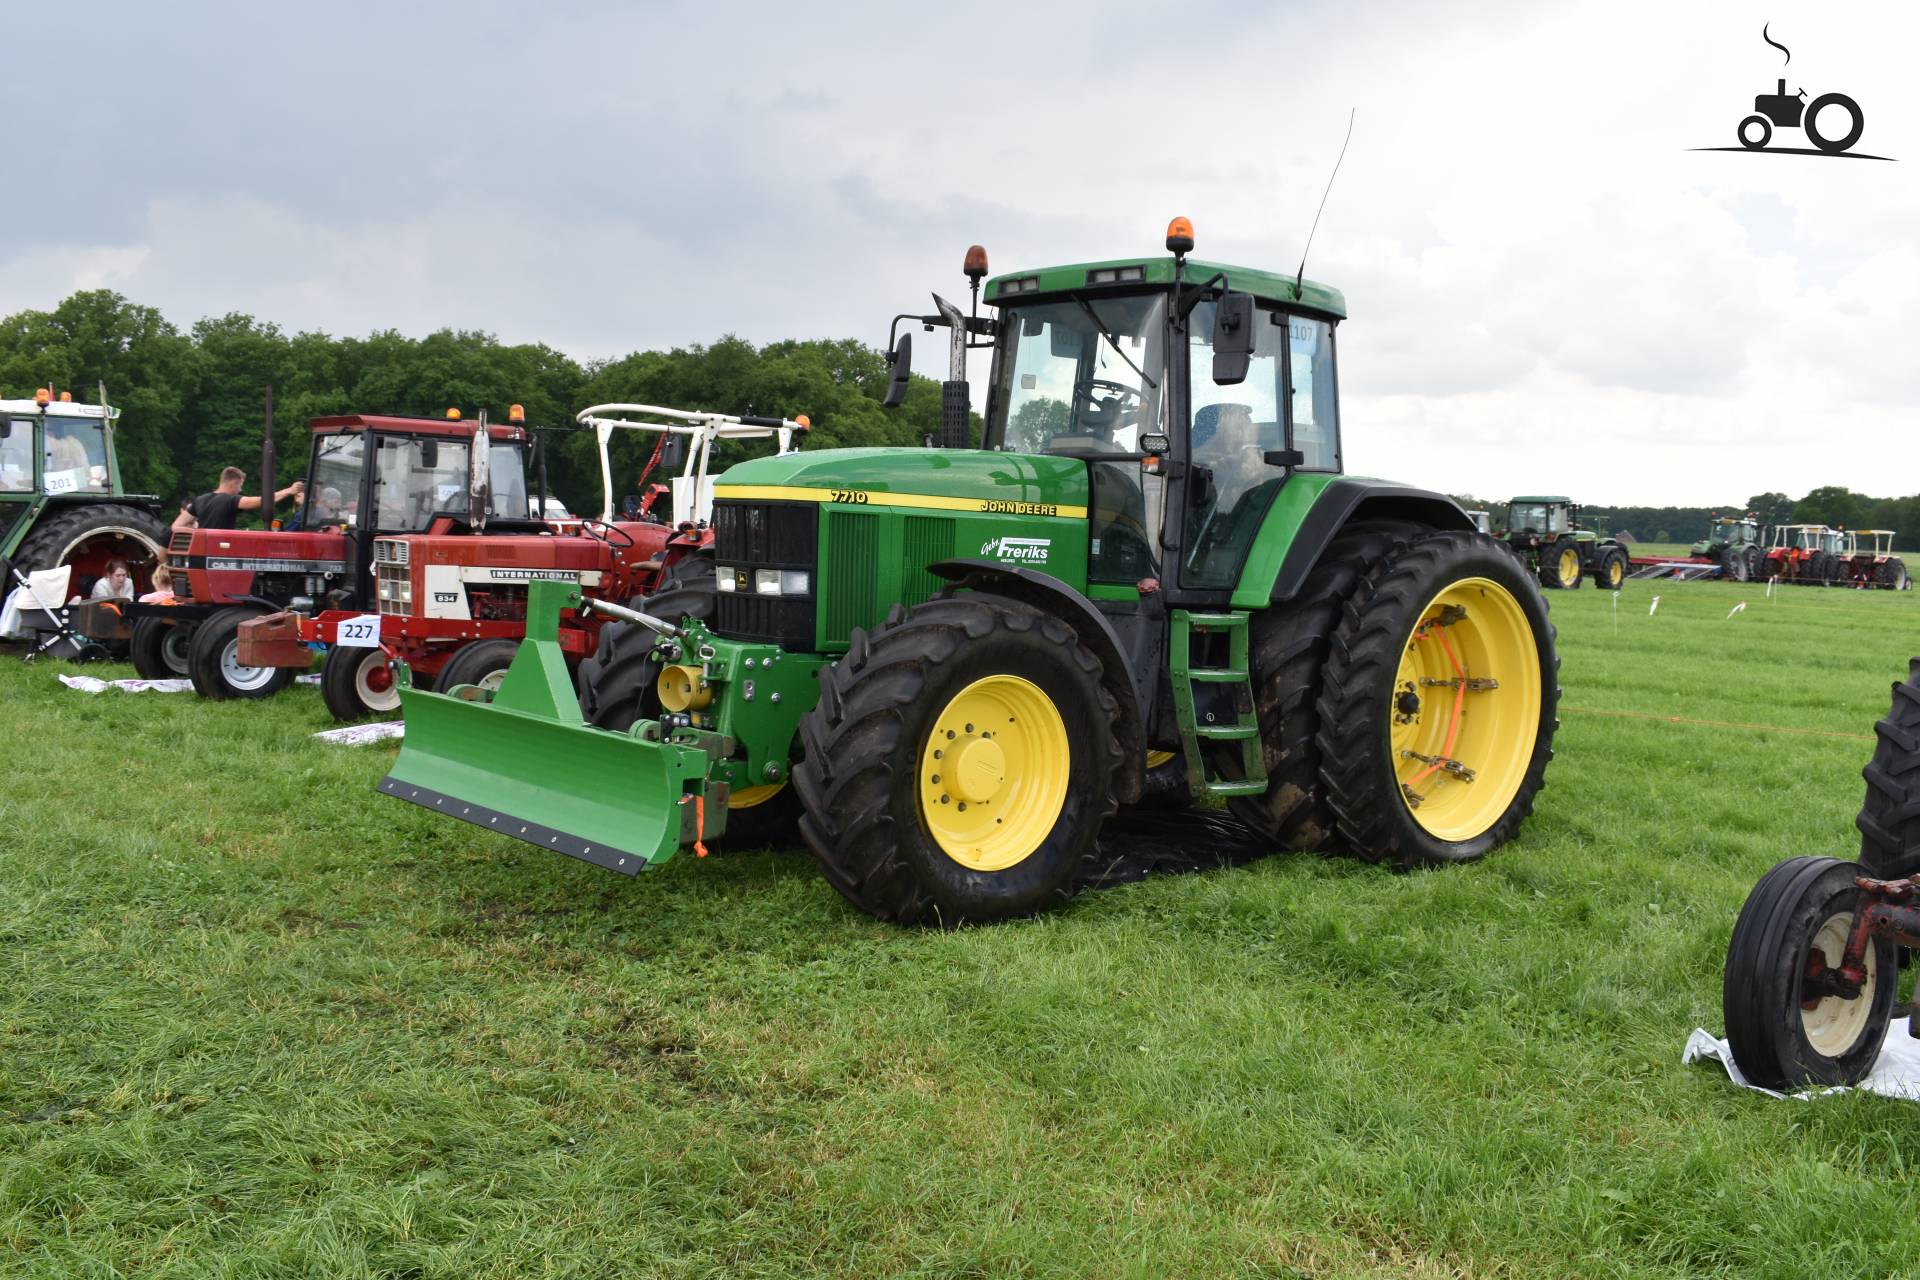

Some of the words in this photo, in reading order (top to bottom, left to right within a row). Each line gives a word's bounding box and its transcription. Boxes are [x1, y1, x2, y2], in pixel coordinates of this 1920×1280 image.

[50, 477, 72, 490] 201
[831, 489, 868, 504] 7710
[981, 501, 1015, 513] JOHN
[1018, 503, 1056, 516] DEERE
[996, 537, 1051, 559] Freriks
[241, 563, 307, 571] INTERNATIONAL
[492, 571, 576, 580] INTERNATIONAL
[344, 624, 373, 639] 227
